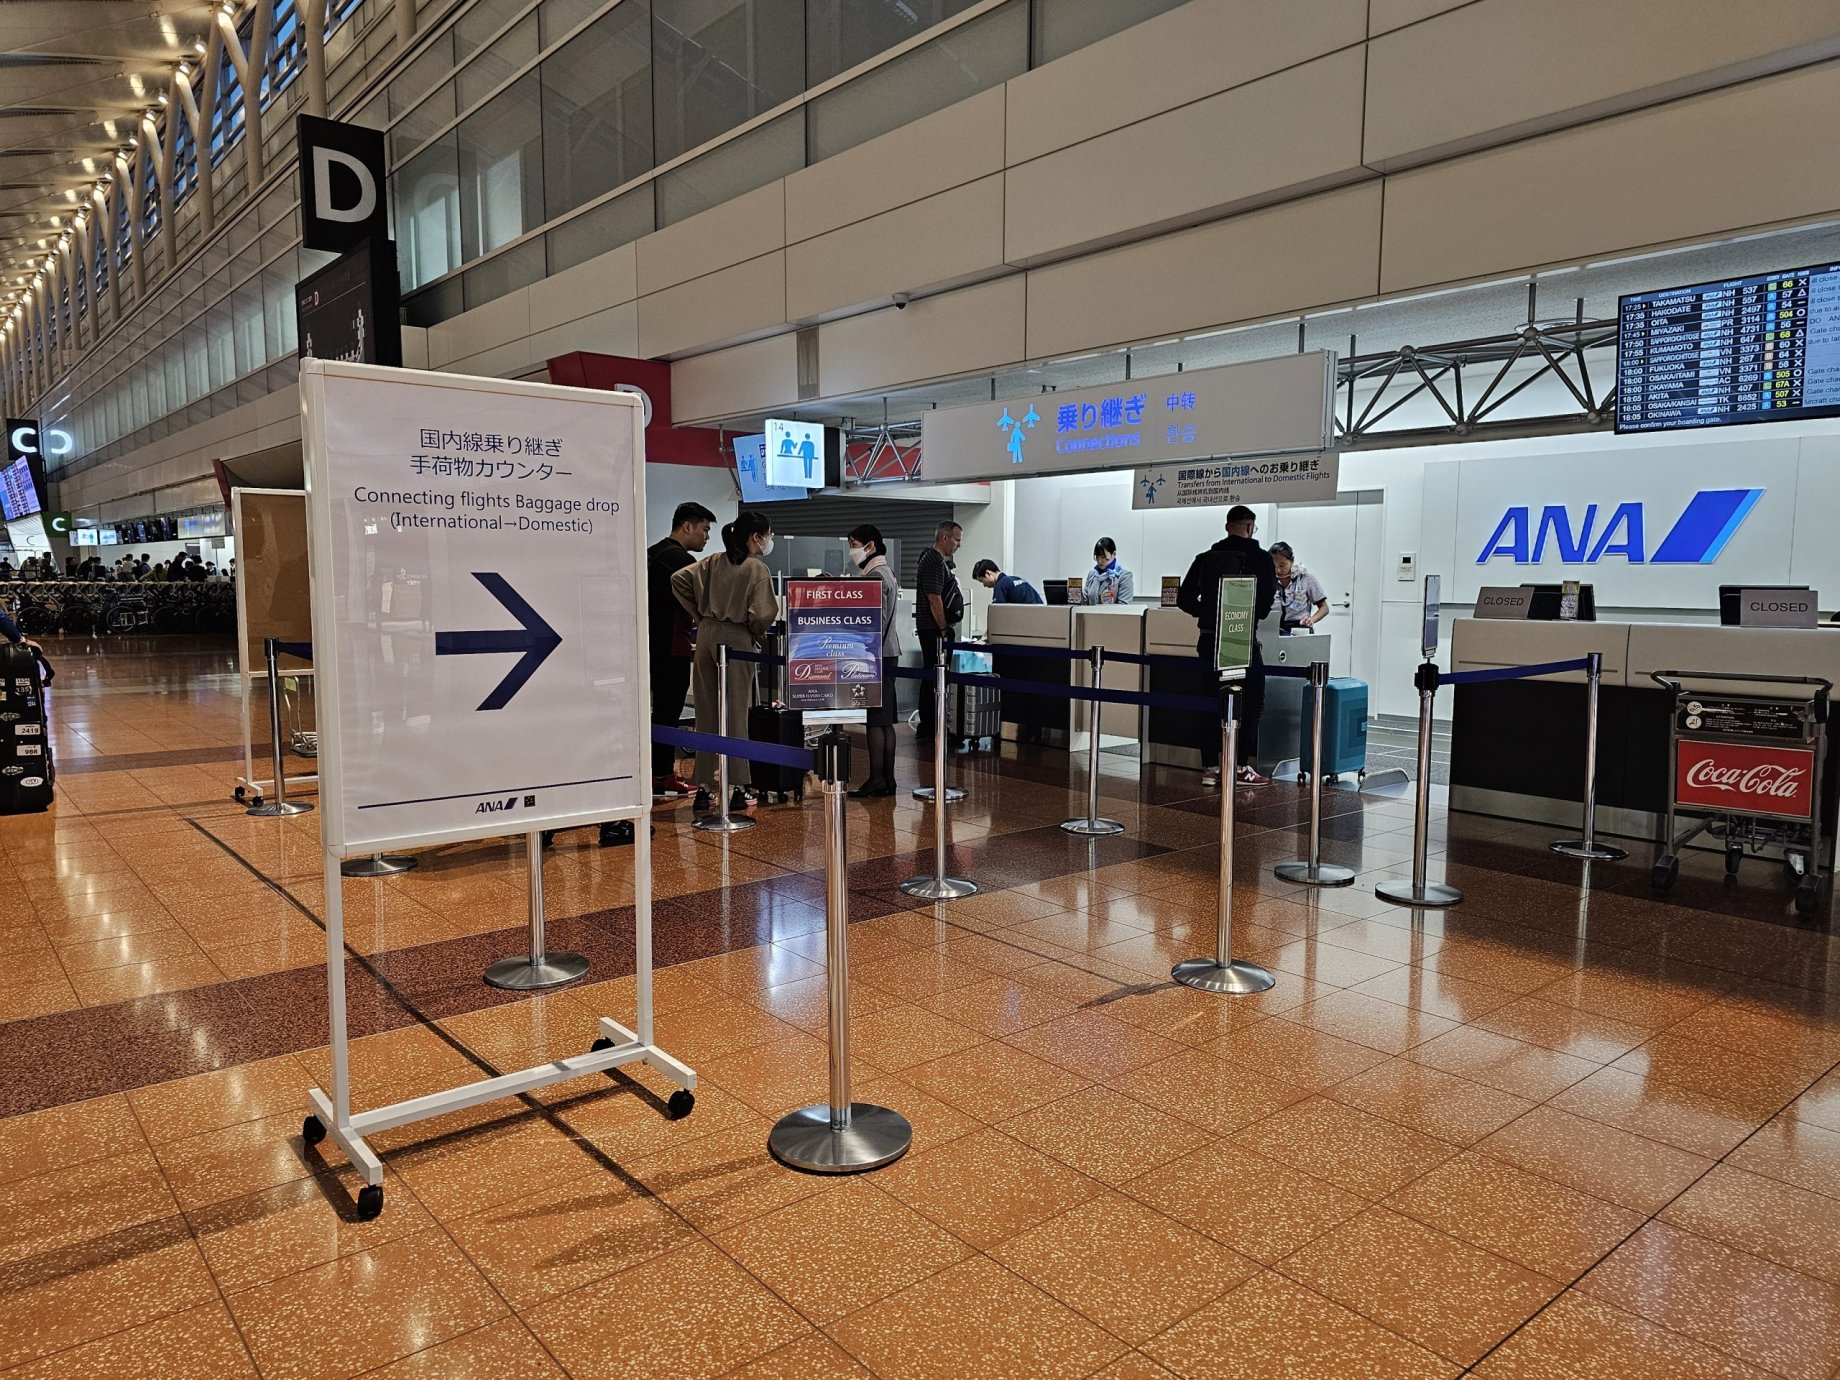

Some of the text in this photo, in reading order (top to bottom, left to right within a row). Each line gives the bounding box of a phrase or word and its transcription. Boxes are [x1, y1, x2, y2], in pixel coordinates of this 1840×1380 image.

[313, 146, 376, 222] D
[1652, 295, 1696, 307] TAKAMATSU
[1626, 312, 1645, 320] 17:35
[1651, 306, 1691, 317] HAKODATE
[1626, 322, 1644, 330] 17:35
[1742, 305, 1761, 314] 2497
[1650, 325, 1684, 336] MIYAZAKI
[1741, 315, 1760, 324] 3114
[1740, 325, 1760, 333] 4731
[1624, 350, 1643, 358] 17:55
[1650, 343, 1693, 354] KUMAMOTO
[1740, 345, 1759, 353] 3373
[1649, 363, 1685, 373] FUKUOKA
[1740, 355, 1754, 363] 267
[1739, 364, 1758, 373] 3371
[1649, 382, 1684, 391] OKAYAMA
[1166, 391, 1196, 411] 中转
[1057, 393, 1147, 433] 乗り継ぎ
[1648, 410, 1682, 419] OKINAWA
[774, 422, 784, 432] 14
[12, 427, 38, 453] C
[420, 429, 562, 457] 国内線乗り継ぎ
[1056, 432, 1140, 453] Connections
[410, 455, 572, 480] 手荷物カウンター
[1178, 459, 1320, 480] 国際線から国内線へのお乗り継ぎ
[1178, 480, 1205, 488] Transfers
[1222, 475, 1264, 485] International
[1273, 473, 1305, 482] Domestic
[1306, 471, 1330, 481] Flights
[354, 487, 620, 515] Connecting flights Baggage drop
[52, 518, 66, 532] C
[1475, 501, 1646, 565] ANA
[806, 590, 863, 599] FIRST CLASS
[1483, 596, 1524, 606] CLOSED
[1750, 601, 1808, 614] CLOSED
[798, 616, 841, 625] BUSINESS
[1225, 611, 1249, 620] ECONOMY
[1229, 624, 1244, 633] CLASS
[816, 635, 854, 649] Premium
[794, 663, 832, 680] Diamond
[841, 663, 877, 679] Platinum
[1686, 758, 1806, 798] Coca-Cola
[475, 800, 503, 814] ANA
